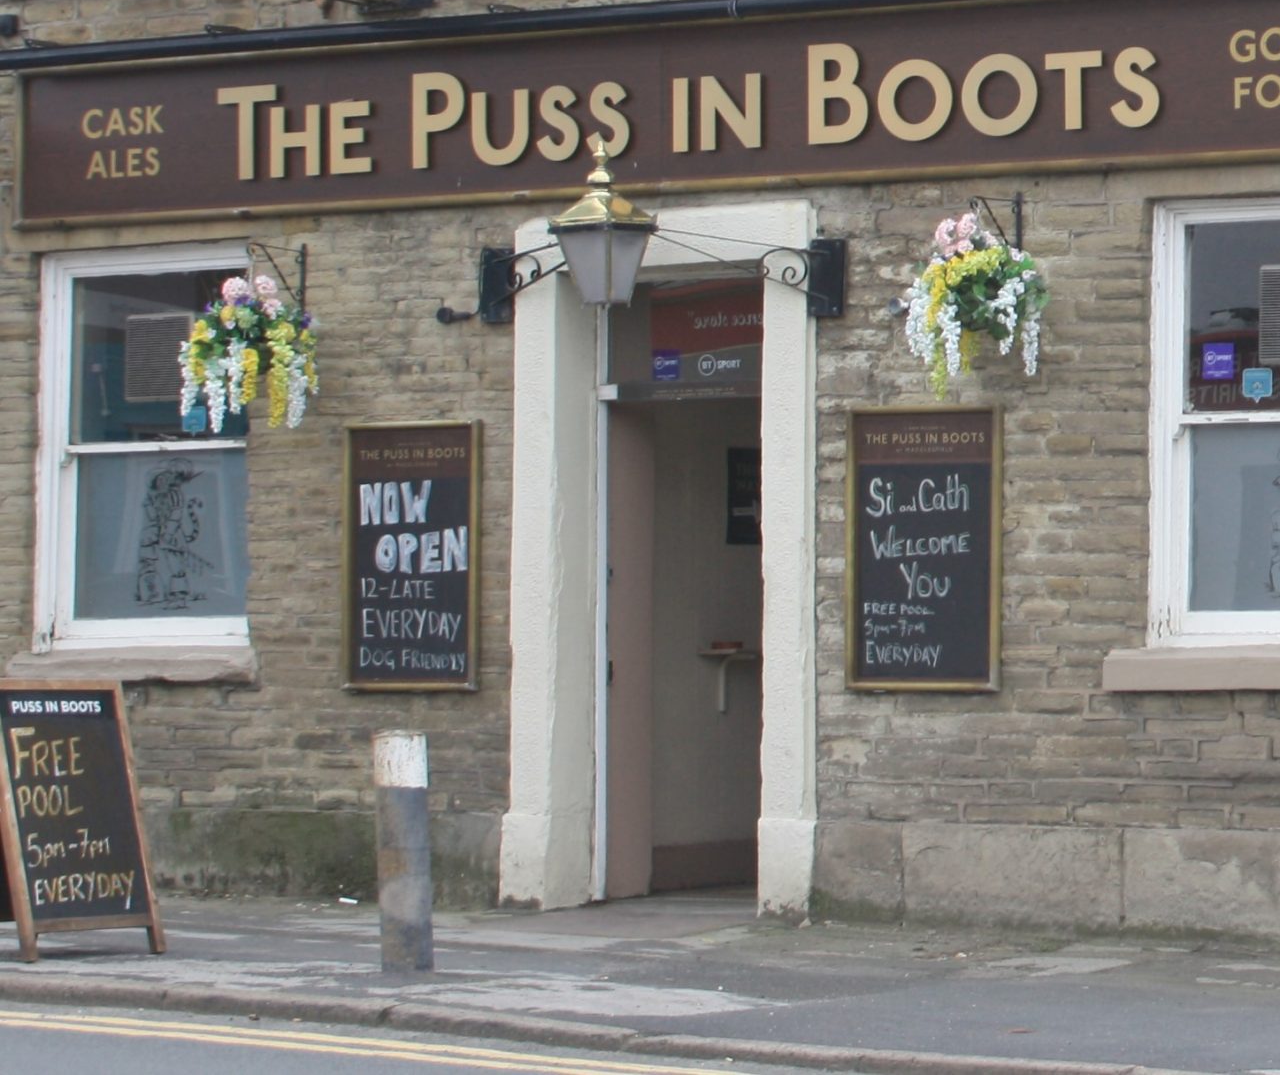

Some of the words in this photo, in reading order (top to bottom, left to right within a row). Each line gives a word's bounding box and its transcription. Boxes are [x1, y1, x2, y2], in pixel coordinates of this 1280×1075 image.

[81, 105, 164, 140] CASK
[217, 84, 373, 181] THE
[411, 72, 631, 171] PUSS
[671, 72, 763, 155] IN
[807, 42, 1161, 146] BOOTS
[85, 147, 162, 180] ALES
[717, 359, 741, 369] SPORT
[360, 449, 380, 460] THE
[384, 448, 409, 459] PUSS
[412, 448, 425, 458] IN
[428, 447, 465, 458] BOOTS
[865, 434, 888, 444] THE
[892, 433, 921, 444] PUSS
[925, 433, 938, 443] IN
[943, 432, 985, 443] BOOTS
[359, 479, 432, 525] NOW
[866, 477, 895, 518] Si
[899, 496, 917, 512] and
[918, 473, 970, 512] Cath
[375, 525, 468, 574] OPEN
[870, 525, 971, 559] WELCOME
[361, 577, 435, 599] 12-LATE
[900, 561, 950, 599] YOU
[362, 608, 461, 642] EVERYDAY
[864, 602, 896, 615] FREE
[900, 603, 935, 615] POOL
[360, 646, 395, 671] DOG
[402, 648, 465, 673] FRIENDLY
[866, 640, 941, 668] EVERYDAY
[11, 700, 42, 713] PUSS
[45, 700, 58, 713] IN
[61, 700, 101, 713] BOOTS
[10, 727, 84, 779] FREE
[18, 785, 83, 818] POOL
[34, 870, 134, 910] EVERYDAY
